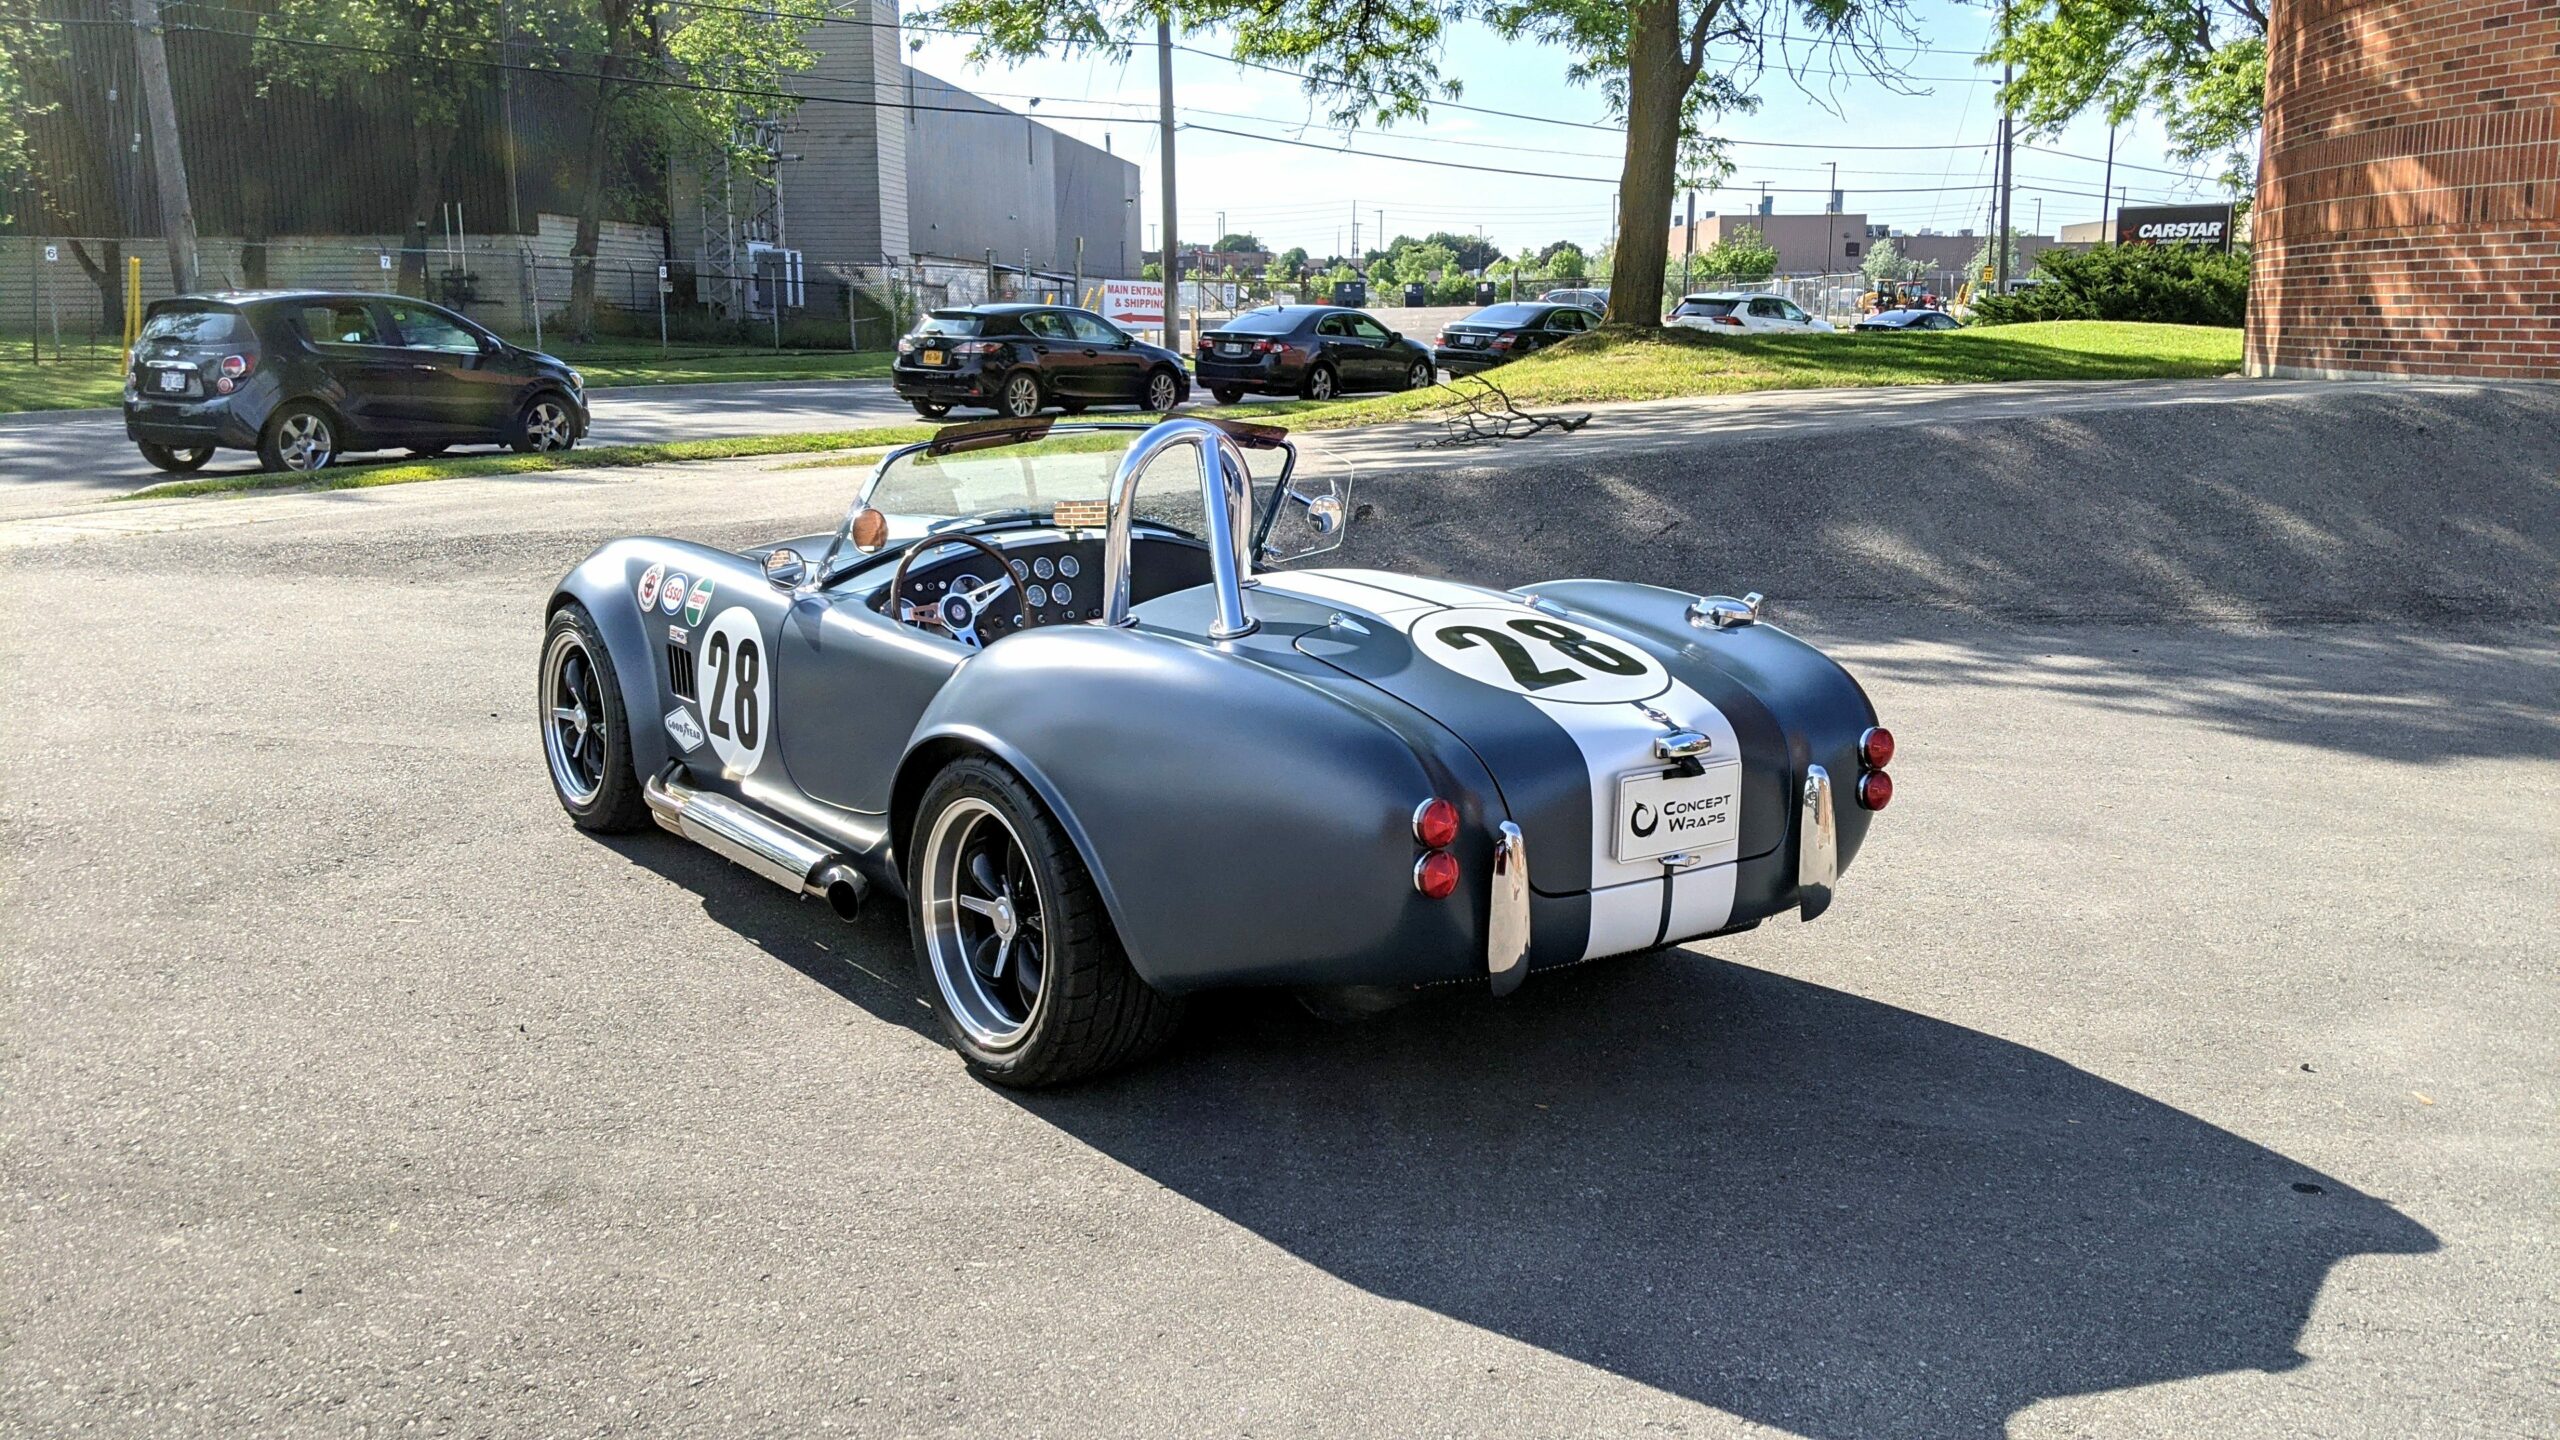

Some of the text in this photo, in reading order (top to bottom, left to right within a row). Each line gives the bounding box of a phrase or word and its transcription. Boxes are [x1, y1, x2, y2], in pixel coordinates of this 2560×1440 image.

[2138, 222, 2222, 238] CARSTAR
[47, 248, 56, 259] 6
[382, 257, 389, 267] 7
[660, 268, 666, 276] 8
[1107, 284, 1129, 295] MAIN
[1114, 298, 1121, 308] &
[1226, 293, 1235, 302] 10
[1435, 618, 1648, 692] 28
[708, 630, 759, 751] 28
